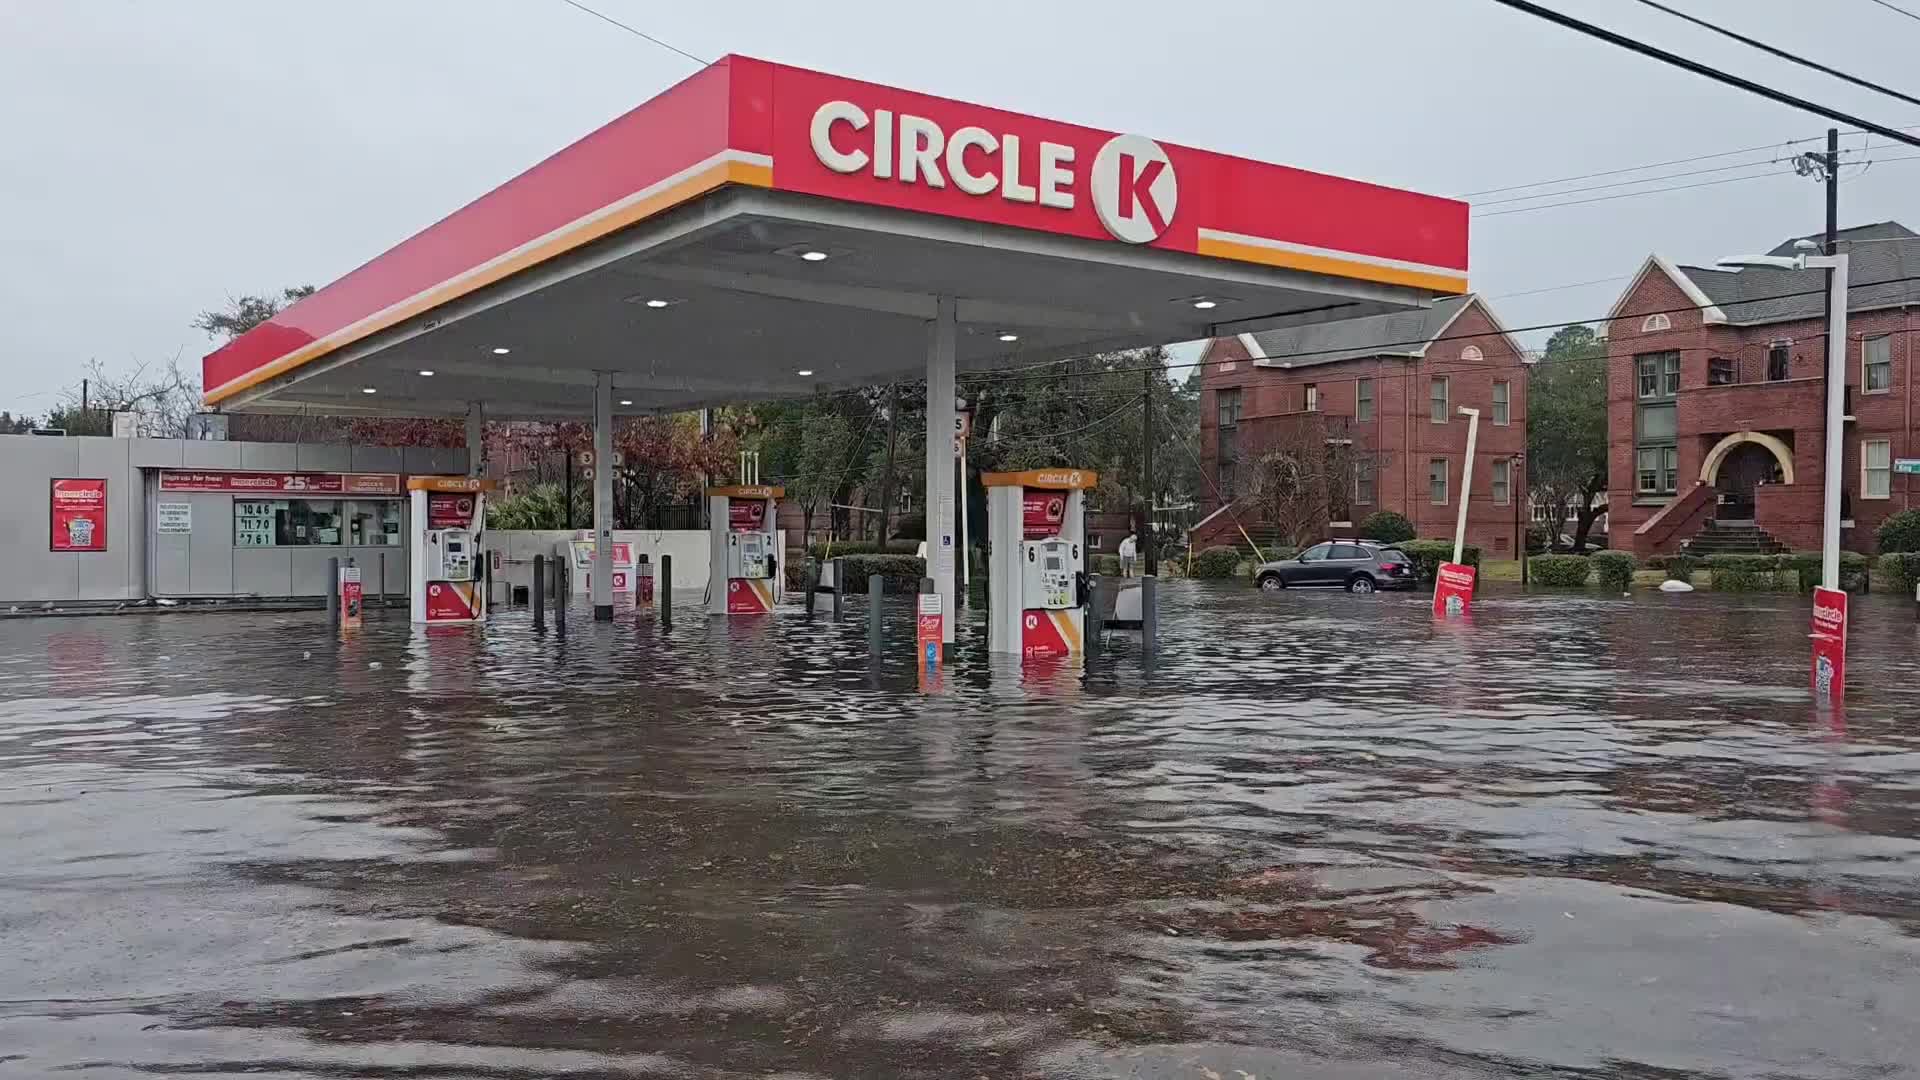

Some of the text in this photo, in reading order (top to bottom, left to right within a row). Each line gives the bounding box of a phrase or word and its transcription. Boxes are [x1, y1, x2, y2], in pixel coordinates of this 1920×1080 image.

[810, 100, 1172, 242] CIRCLE K
[438, 480, 465, 489] CIRCLE
[1038, 473, 1069, 484] CIRCLE
[738, 487, 763, 496] CIRCLE
[431, 532, 438, 545] 4
[731, 535, 737, 546] 2
[766, 535, 772, 546] 2
[1028, 546, 1036, 562] 6
[1071, 544, 1079, 560] 6
[431, 584, 440, 596] K
[1027, 615, 1037, 628] K
